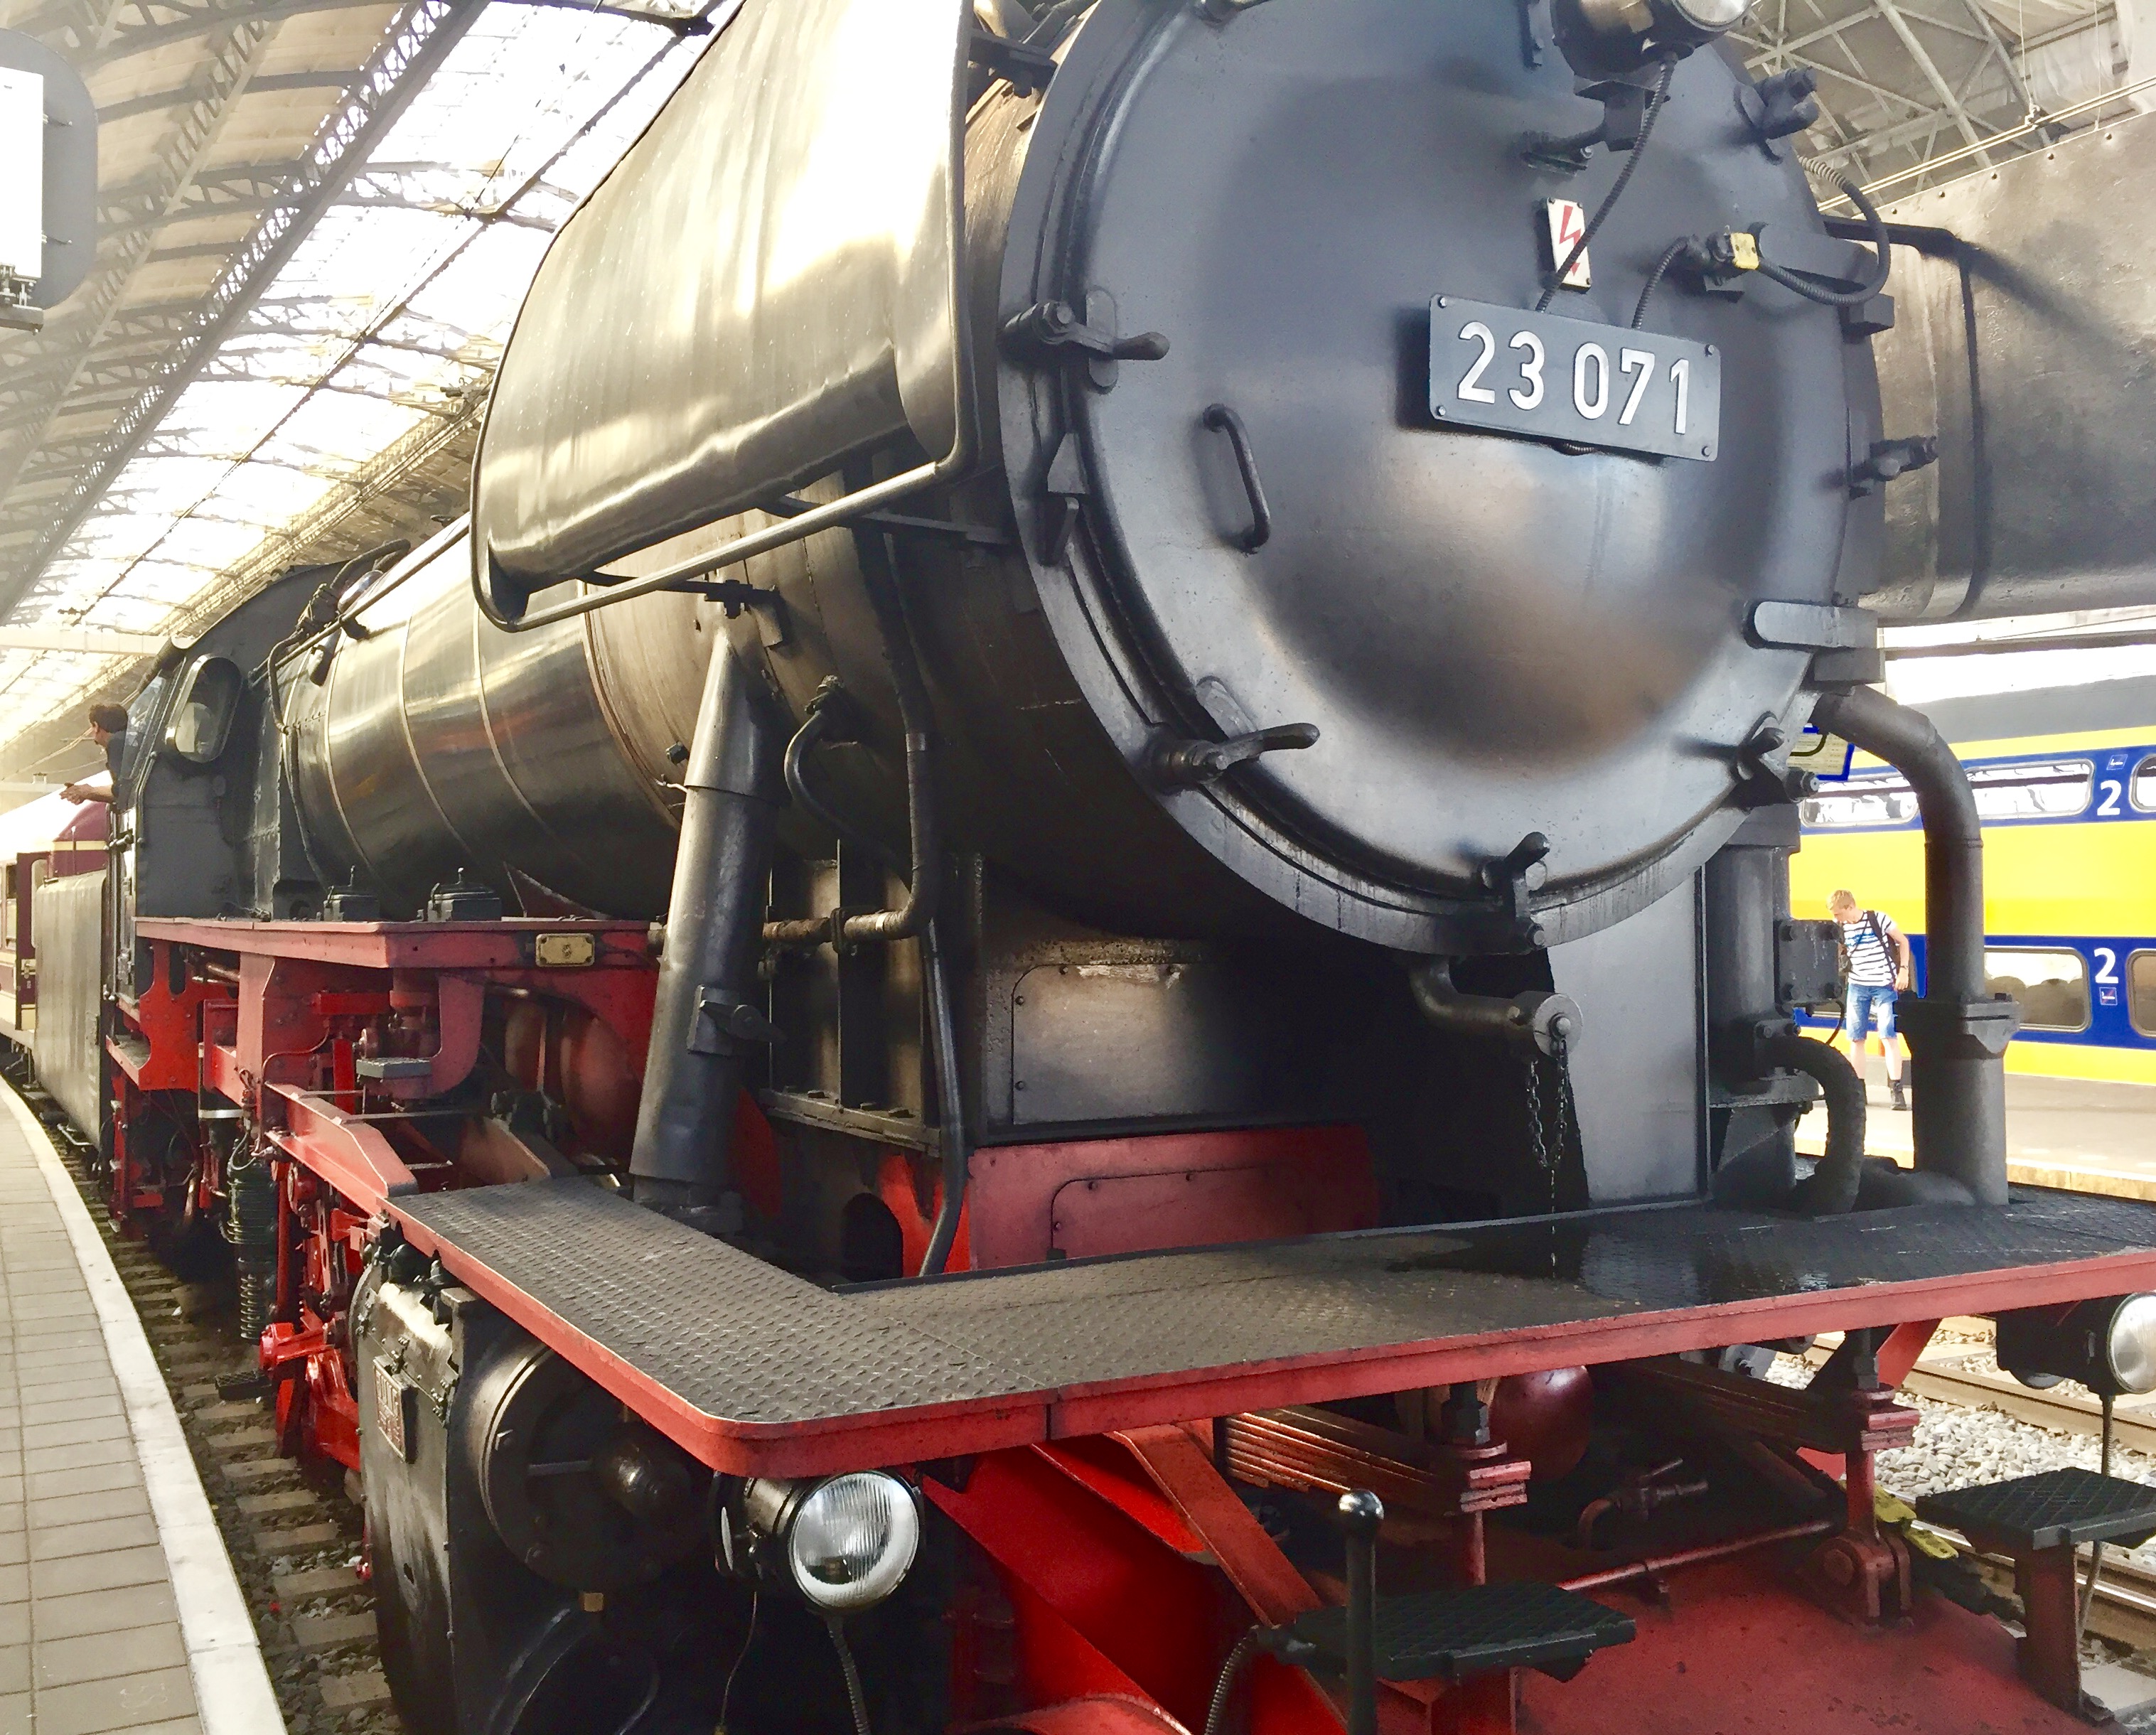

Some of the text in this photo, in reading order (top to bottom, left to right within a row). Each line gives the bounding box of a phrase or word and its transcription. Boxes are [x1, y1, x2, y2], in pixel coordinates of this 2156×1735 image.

[1457, 321, 1689, 434] 23 071
[2097, 780, 2122, 816] 2
[2093, 947, 2119, 984] 2
